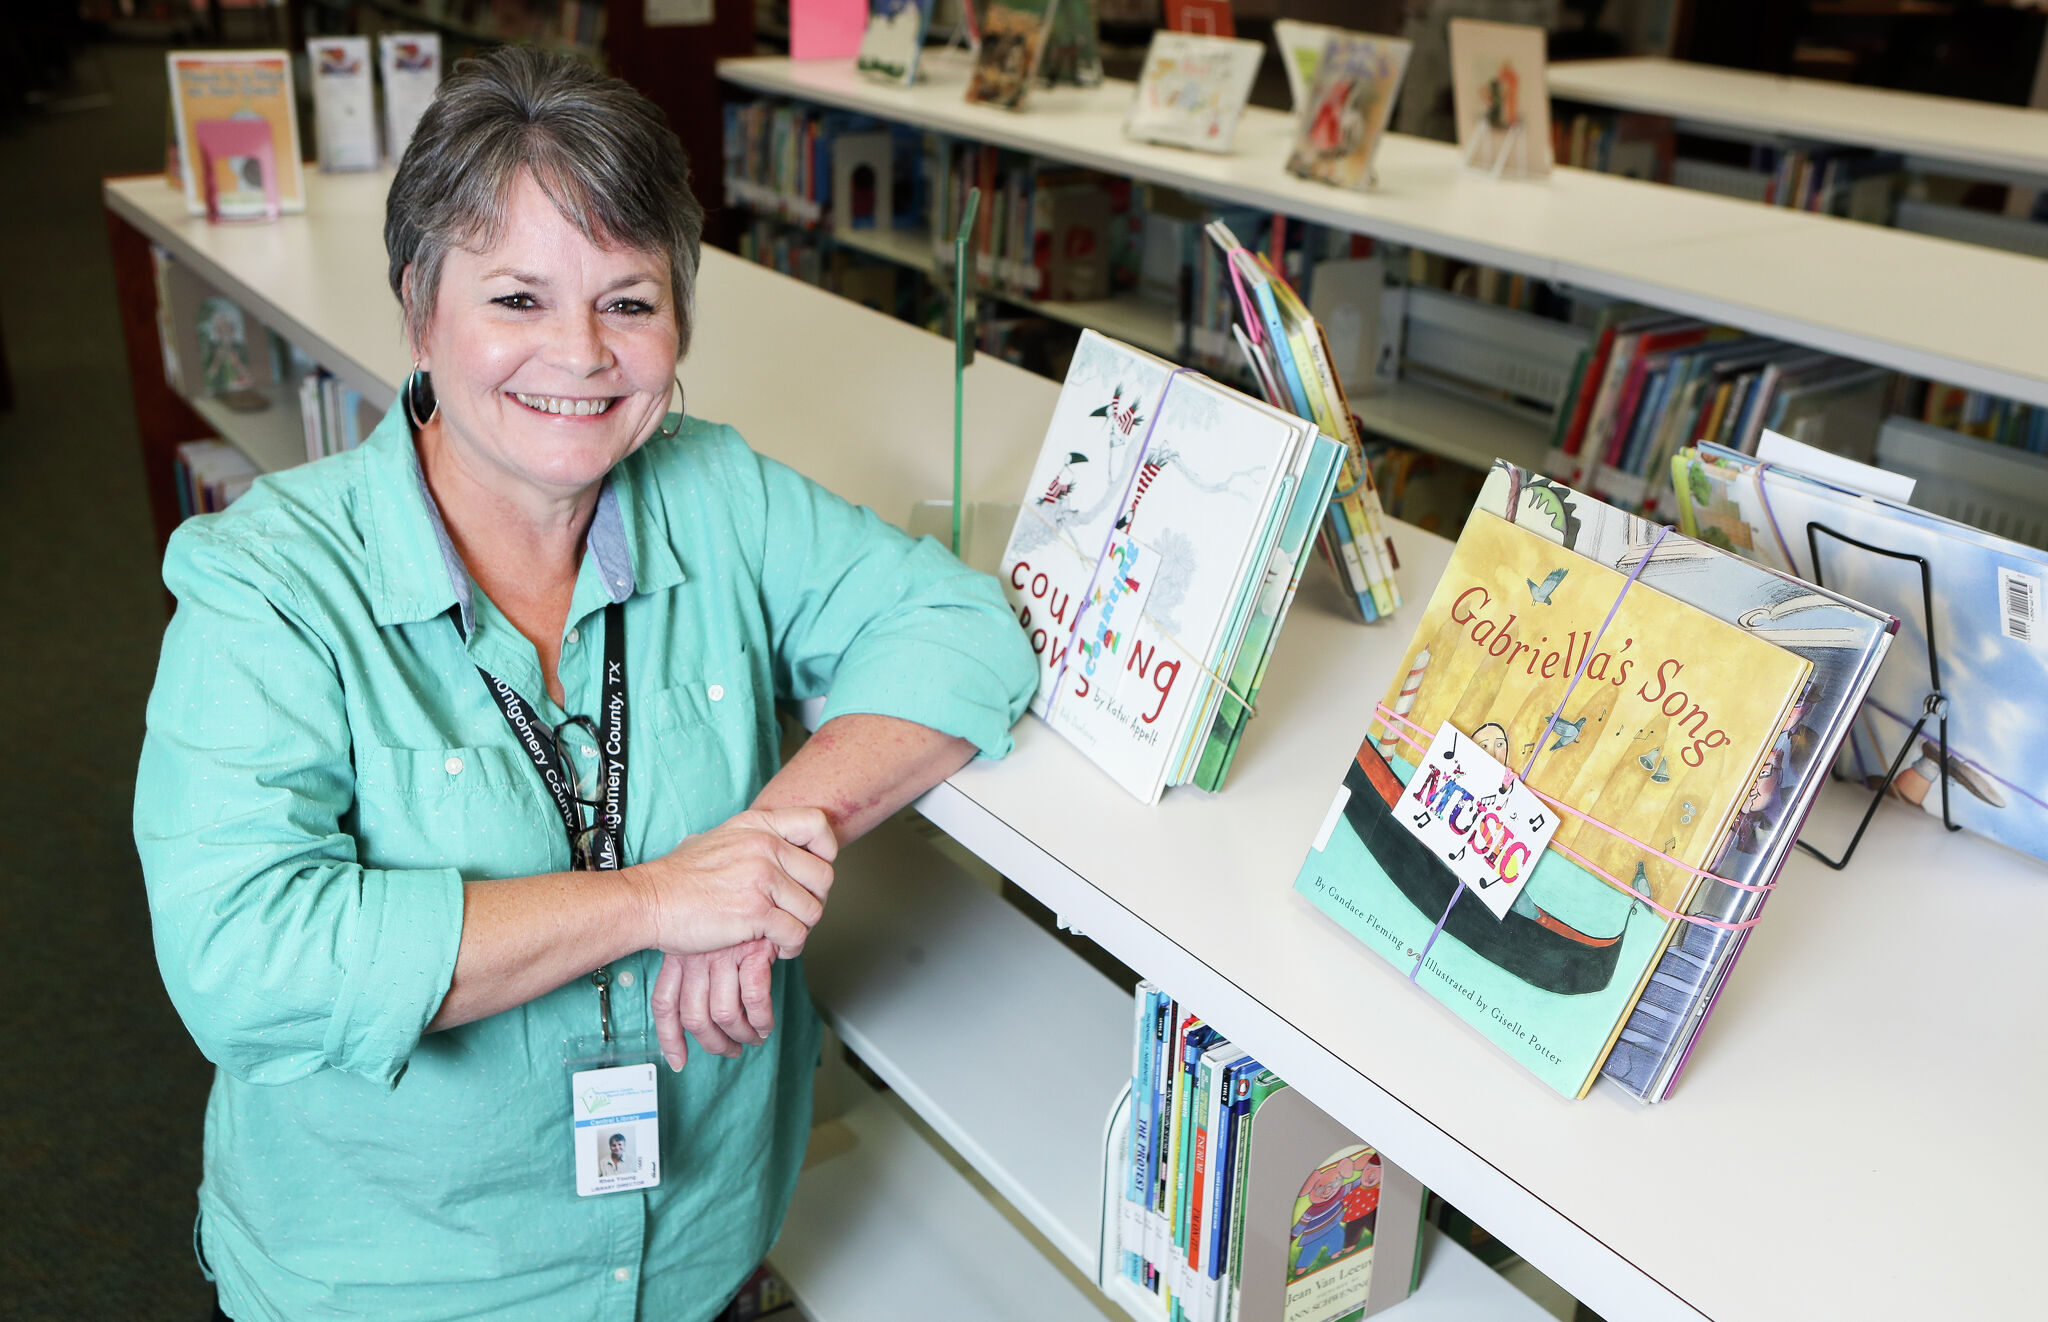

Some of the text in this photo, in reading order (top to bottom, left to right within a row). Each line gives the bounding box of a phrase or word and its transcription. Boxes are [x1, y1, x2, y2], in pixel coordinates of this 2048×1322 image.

[609, 660, 621, 685] TX
[1094, 688, 1104, 711] by
[1451, 586, 1731, 768] Gabriella's Song
[1413, 764, 1532, 884] MUSIC
[1315, 876, 1562, 1066] By Candace Fleming Illustrated by Giselle Potter
[1135, 1119, 1148, 1193] THE PROTEST
